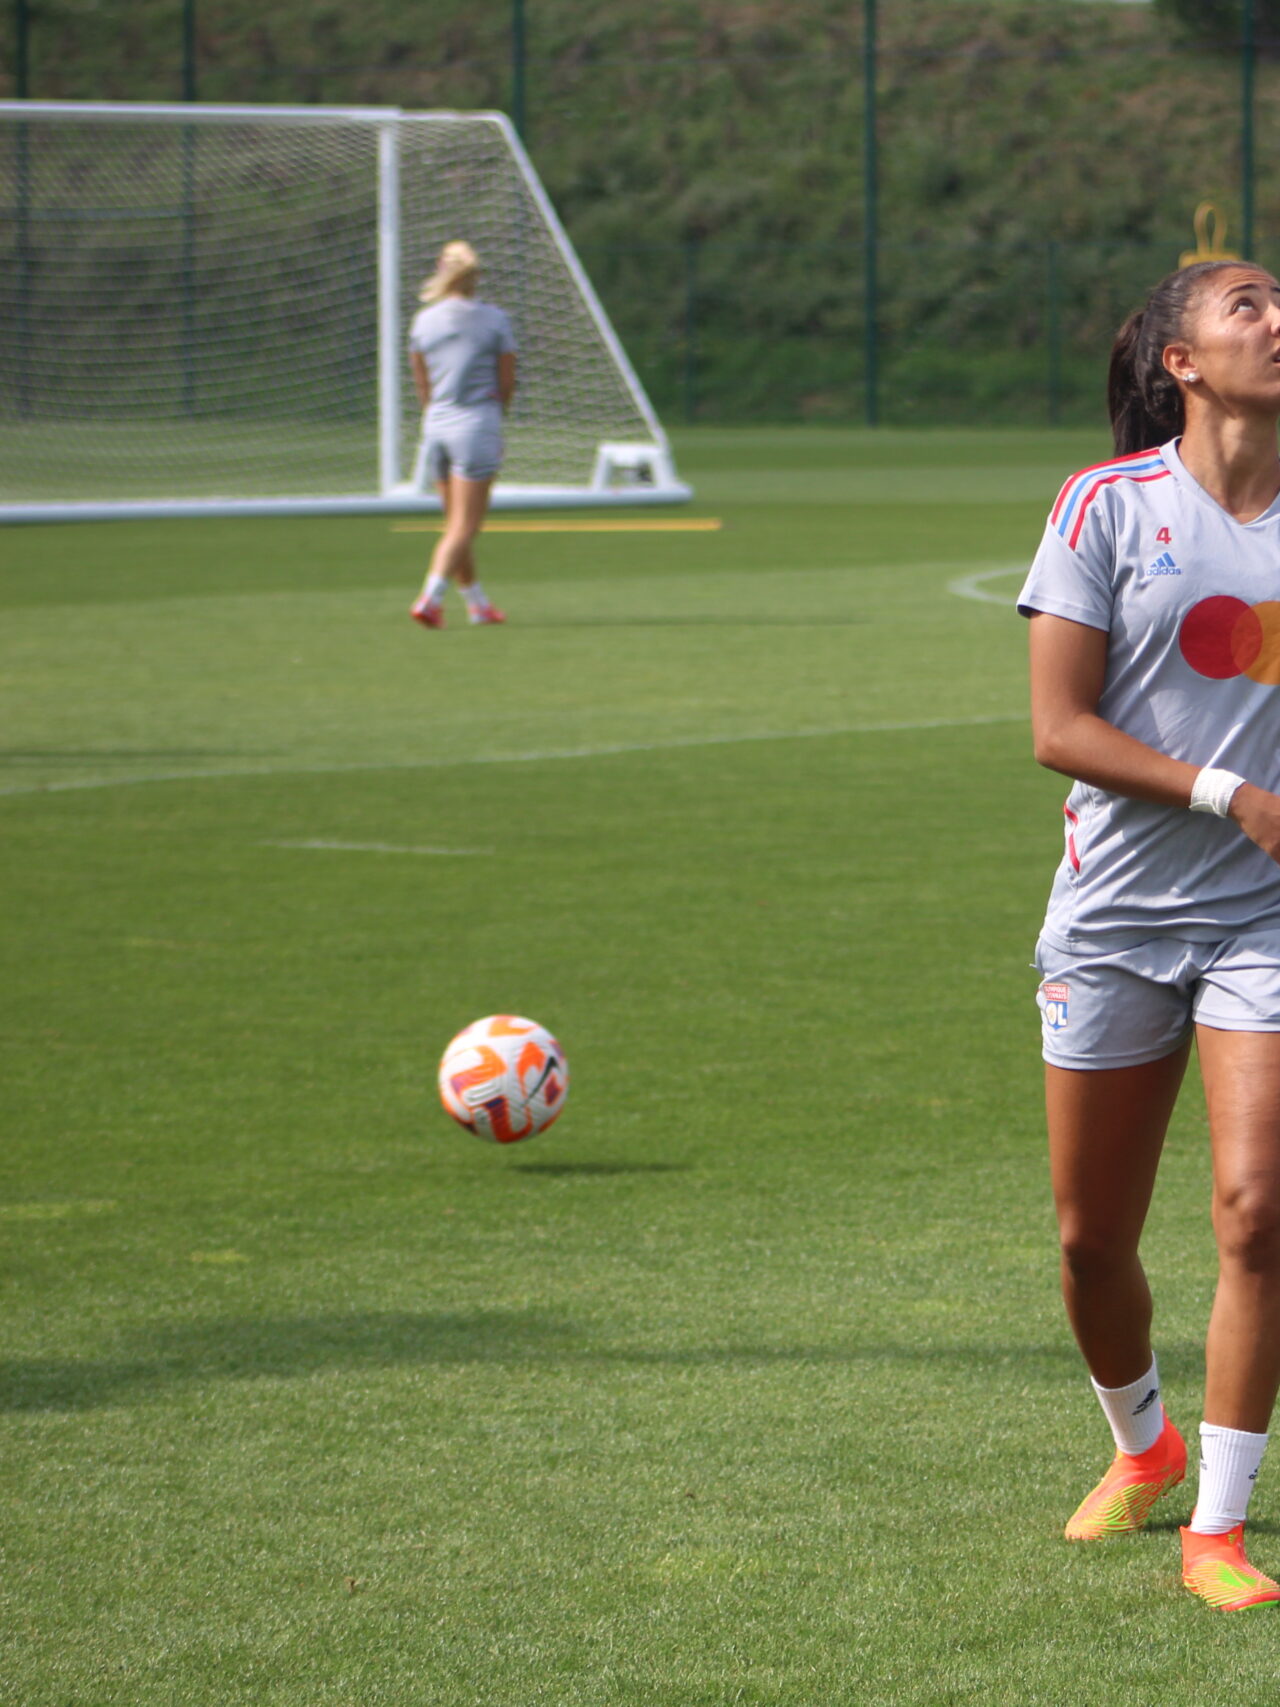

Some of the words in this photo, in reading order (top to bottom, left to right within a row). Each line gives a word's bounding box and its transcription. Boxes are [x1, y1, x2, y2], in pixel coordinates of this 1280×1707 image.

[1156, 527, 1172, 544] 4
[1146, 566, 1182, 576] adidas
[1046, 1003, 1067, 1026] OL
